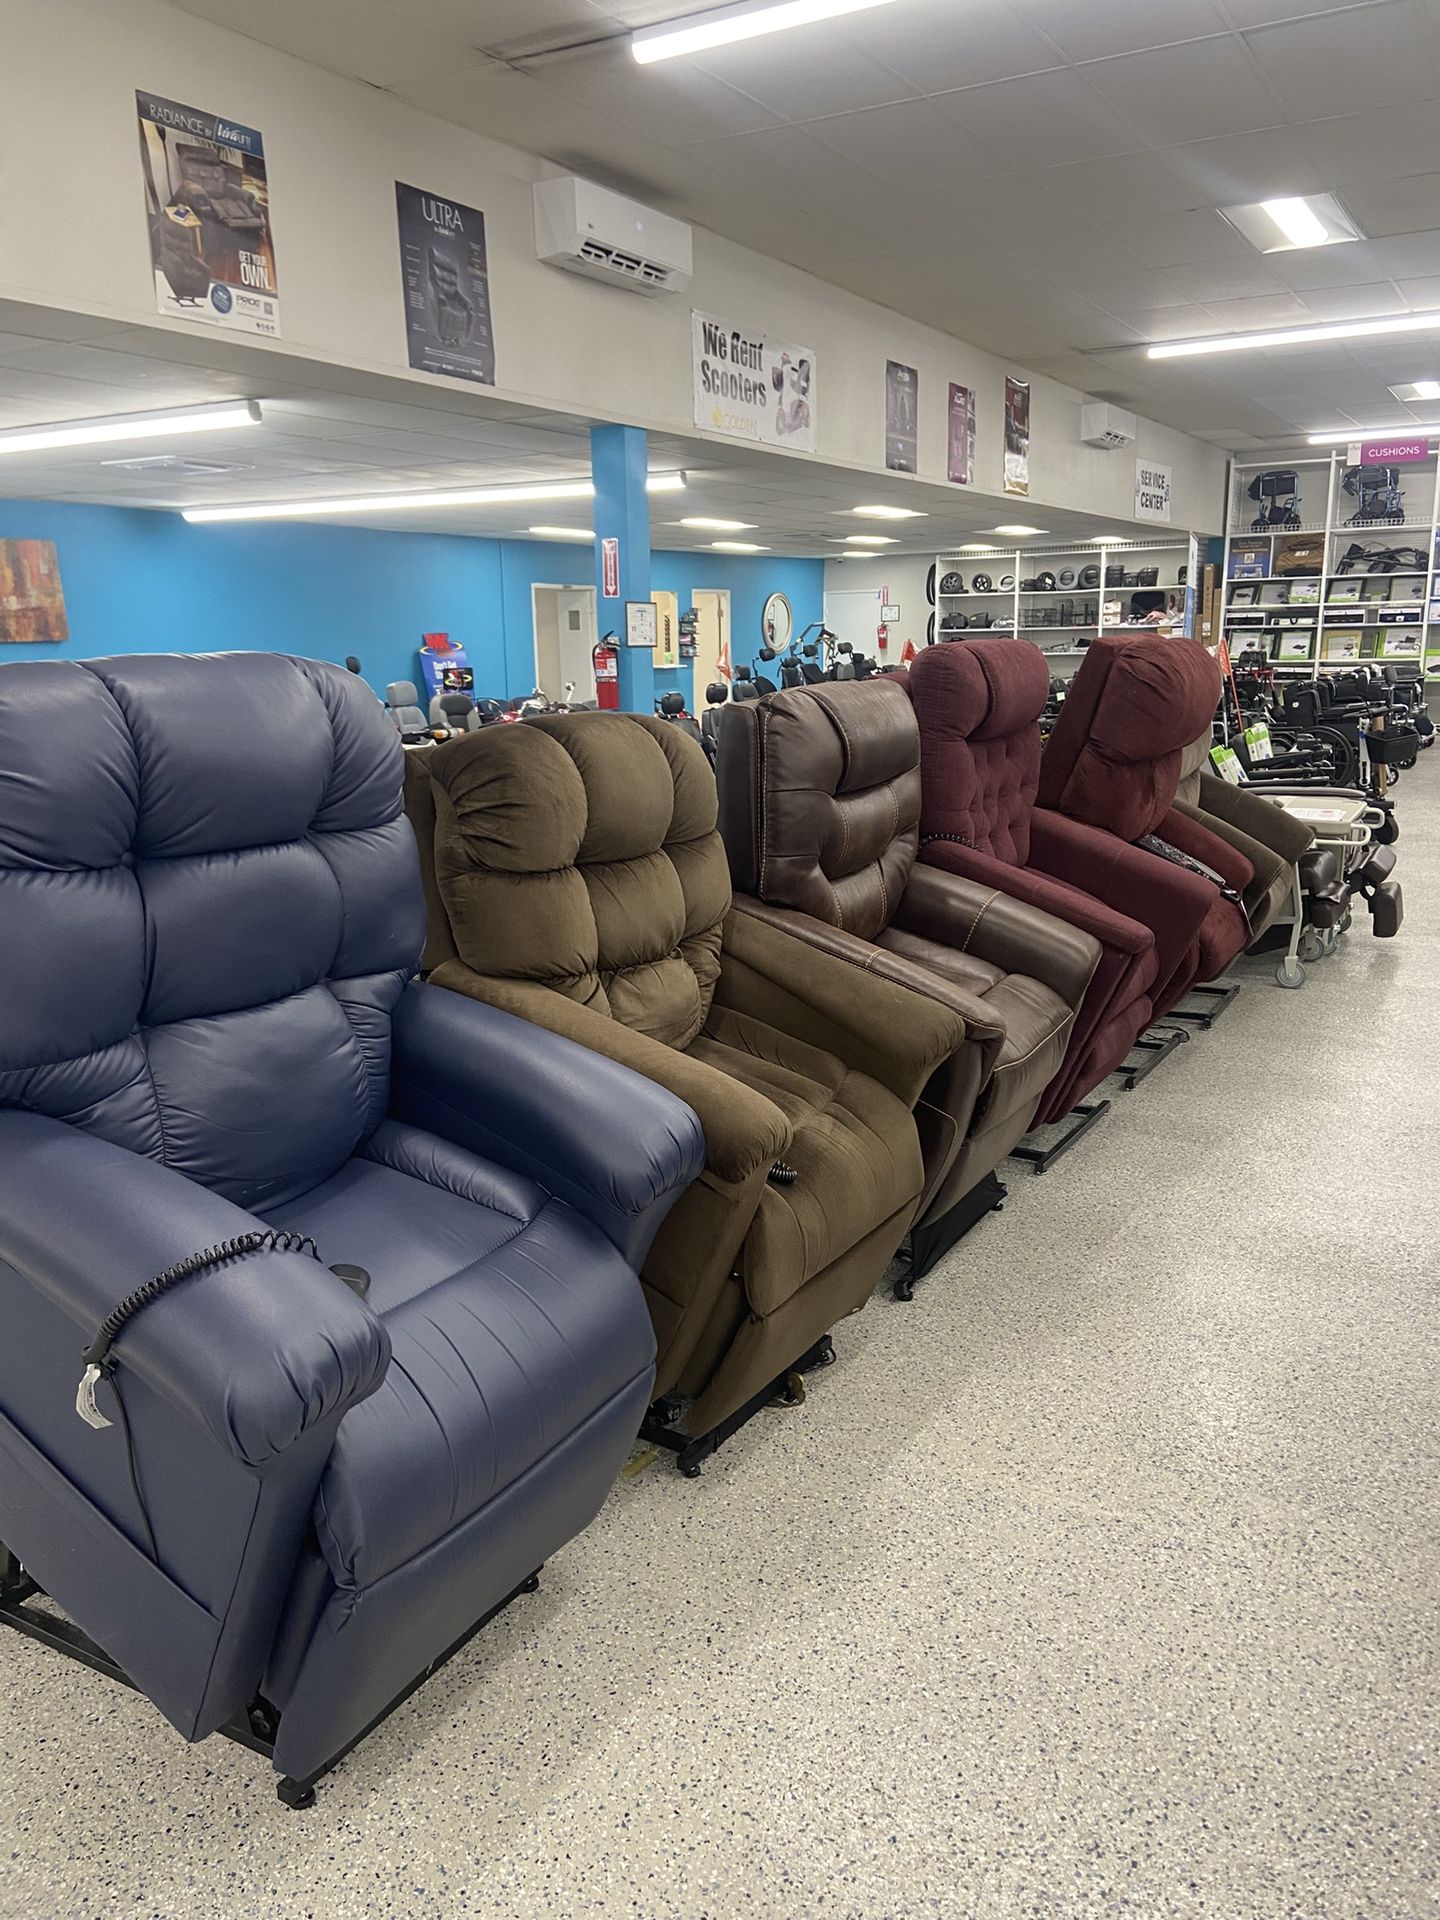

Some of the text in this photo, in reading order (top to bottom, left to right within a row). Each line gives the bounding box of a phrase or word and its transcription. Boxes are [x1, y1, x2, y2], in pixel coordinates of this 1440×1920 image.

[149, 103, 204, 135] RADIANCE
[421, 197, 464, 233] ULTRA
[239, 249, 267, 268] GET YOUR
[702, 321, 763, 372] We Rent
[701, 359, 767, 408] Scooters
[1368, 446, 1421, 458] CUSHIONS
[1141, 469, 1165, 490] SERVICE
[1141, 492, 1164, 511] CENTER
